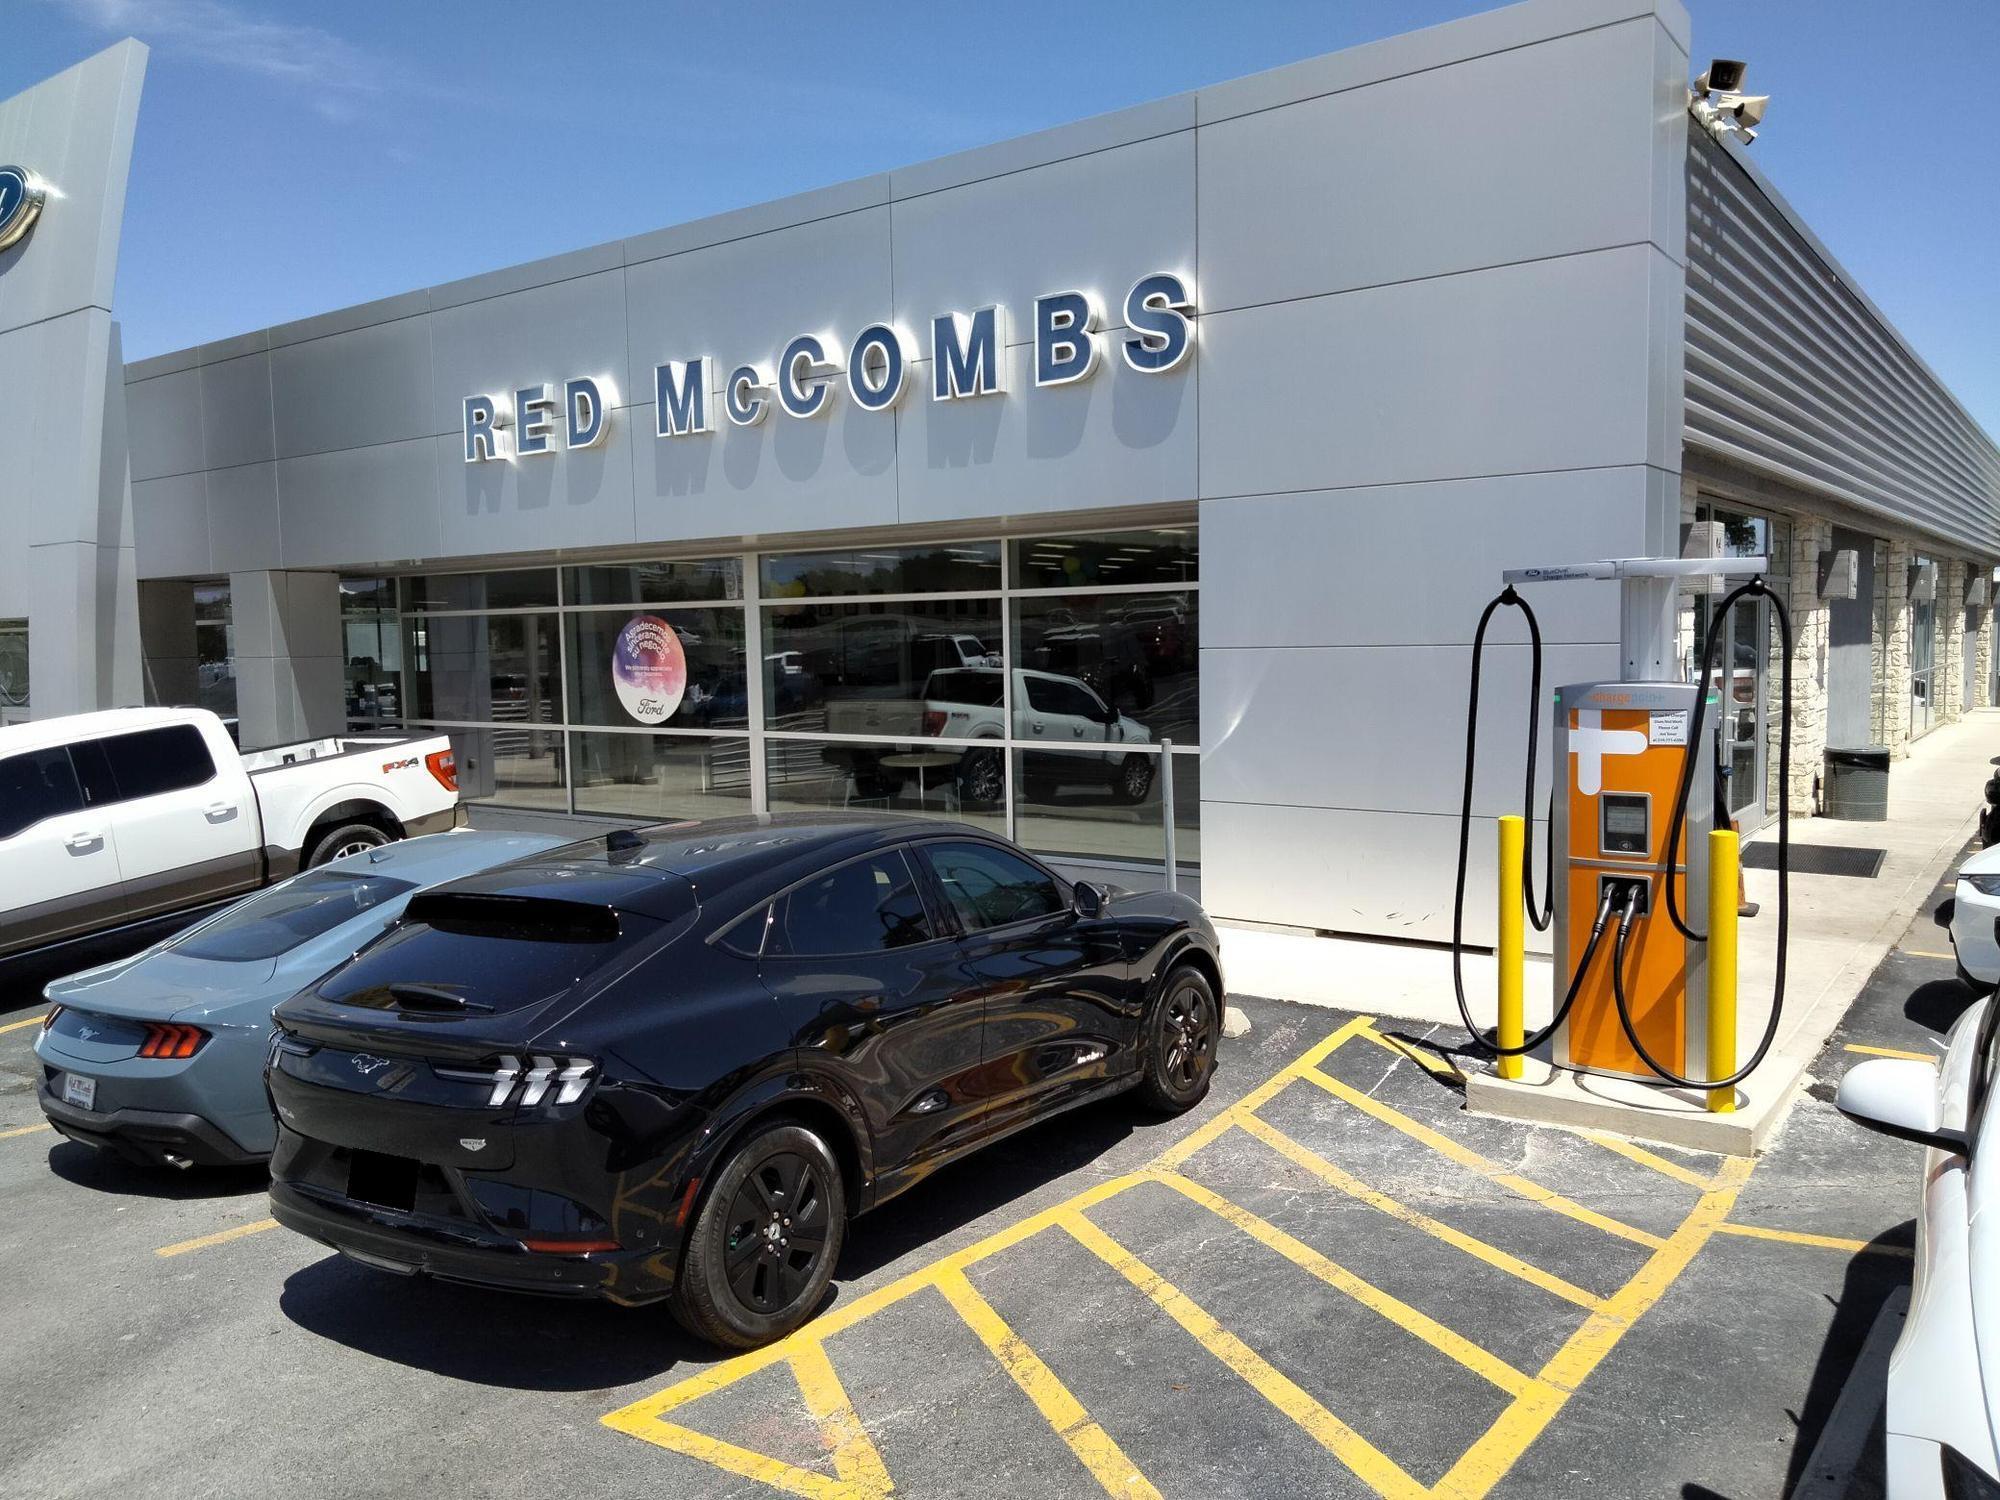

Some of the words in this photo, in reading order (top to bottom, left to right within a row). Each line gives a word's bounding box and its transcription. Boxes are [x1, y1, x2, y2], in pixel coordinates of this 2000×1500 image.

[463, 376, 611, 462] RED
[654, 271, 1196, 438] McCOMBS
[625, 621, 672, 643] Agradecemos
[627, 632, 671, 654] sinceramente
[632, 646, 640, 660] su
[637, 698, 665, 716] Ford
[382, 757, 419, 774] FX4
